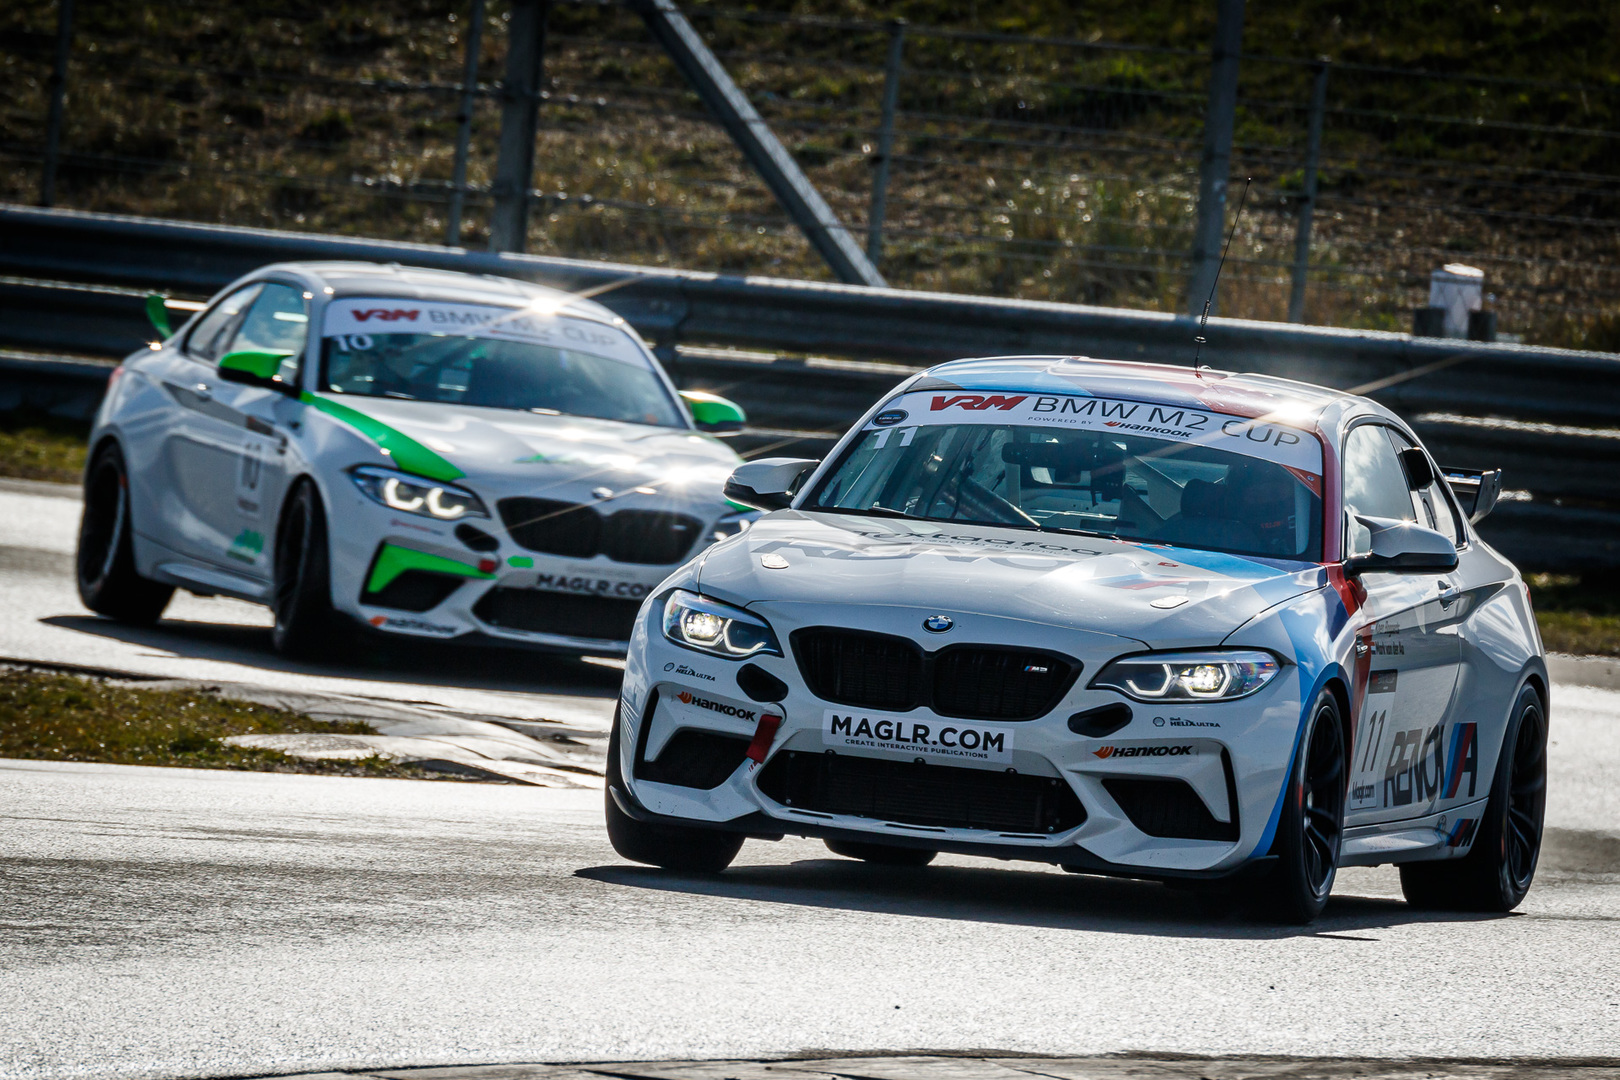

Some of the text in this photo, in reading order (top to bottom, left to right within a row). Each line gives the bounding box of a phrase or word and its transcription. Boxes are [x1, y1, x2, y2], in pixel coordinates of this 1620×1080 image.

[332, 334, 374, 352] 10
[351, 309, 421, 322] VRM
[428, 310, 494, 327] BMW
[560, 326, 617, 347] CUP
[930, 395, 1301, 447] VRM BMW M2 CUP
[1027, 415, 1077, 424] POWERED
[873, 426, 918, 449] 11
[830, 714, 1005, 753] MAGLR.COM
[845, 738, 989, 759] CREATE INTERACTIVE PUBLICATIONS
[1361, 709, 1387, 773] 11
